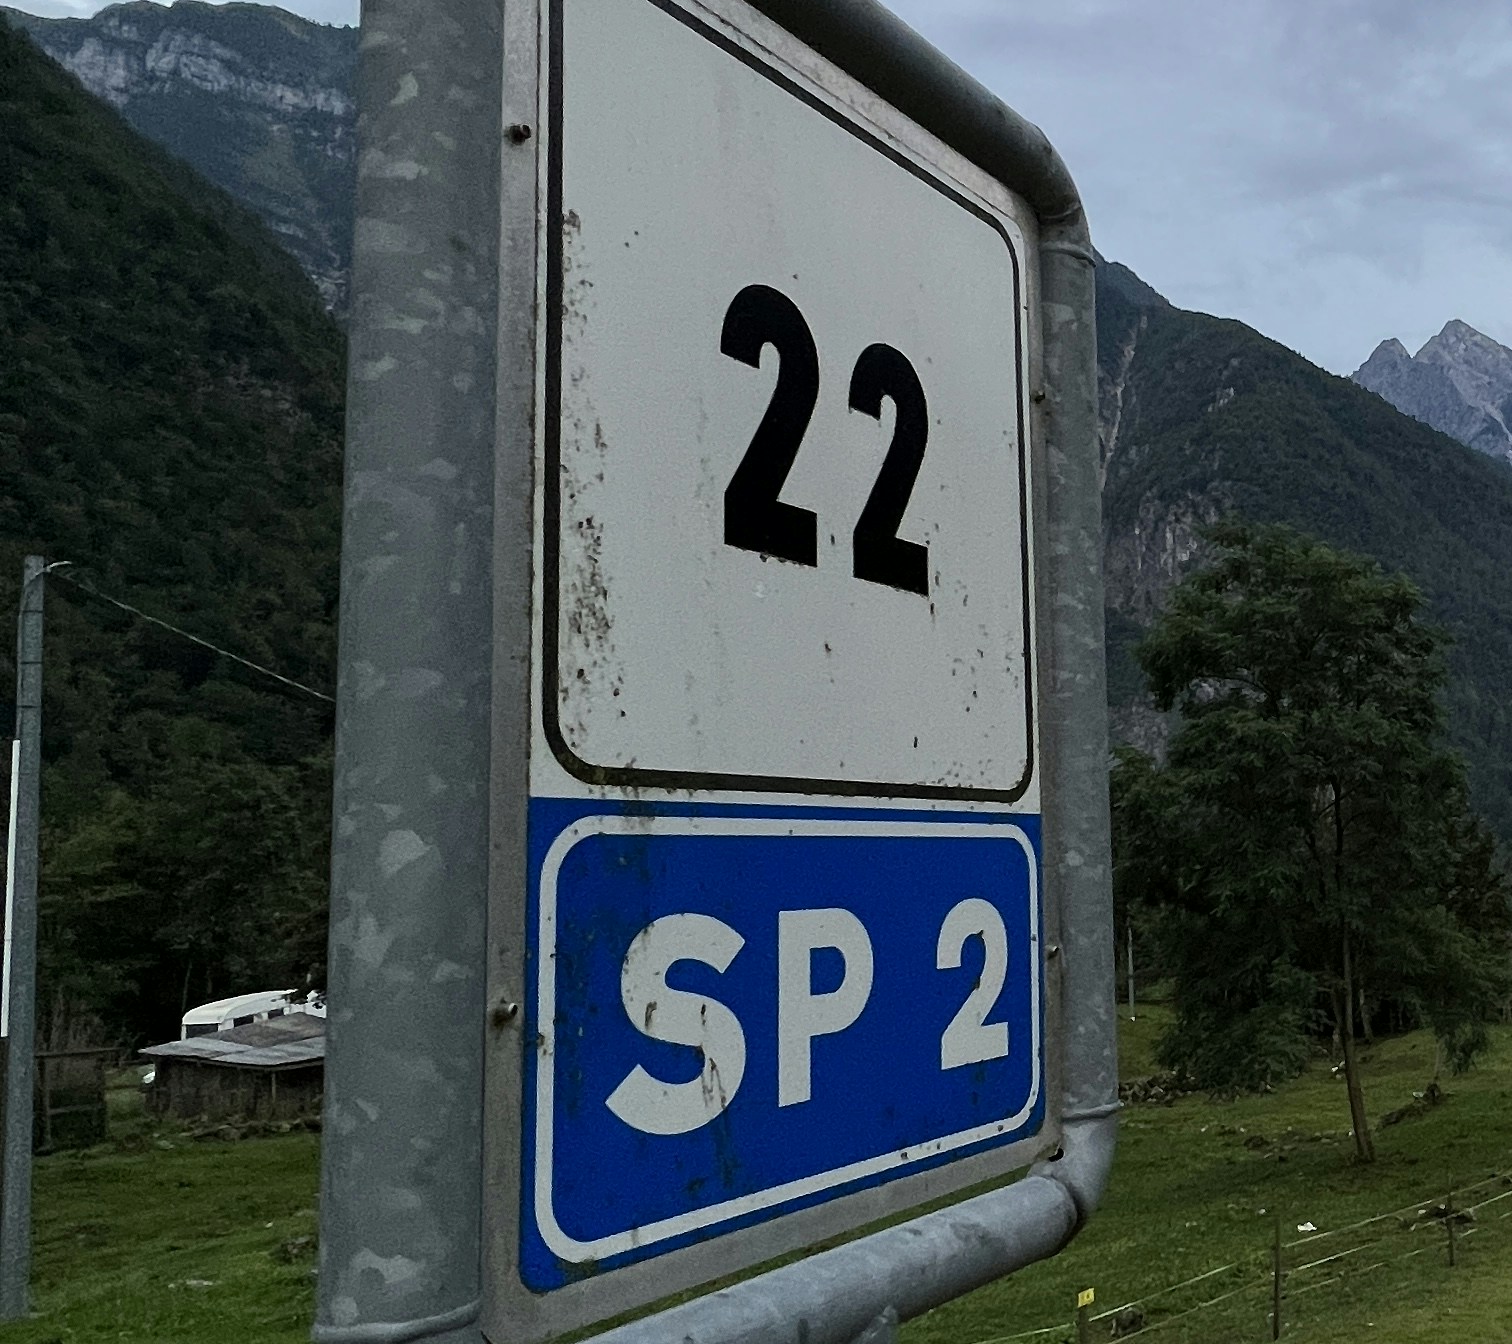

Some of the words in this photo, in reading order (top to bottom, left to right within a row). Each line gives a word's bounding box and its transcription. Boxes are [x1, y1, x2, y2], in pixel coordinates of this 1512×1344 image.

[721, 283, 928, 597] 22
[605, 908, 873, 1135] SP
[936, 898, 1008, 1070] 2
